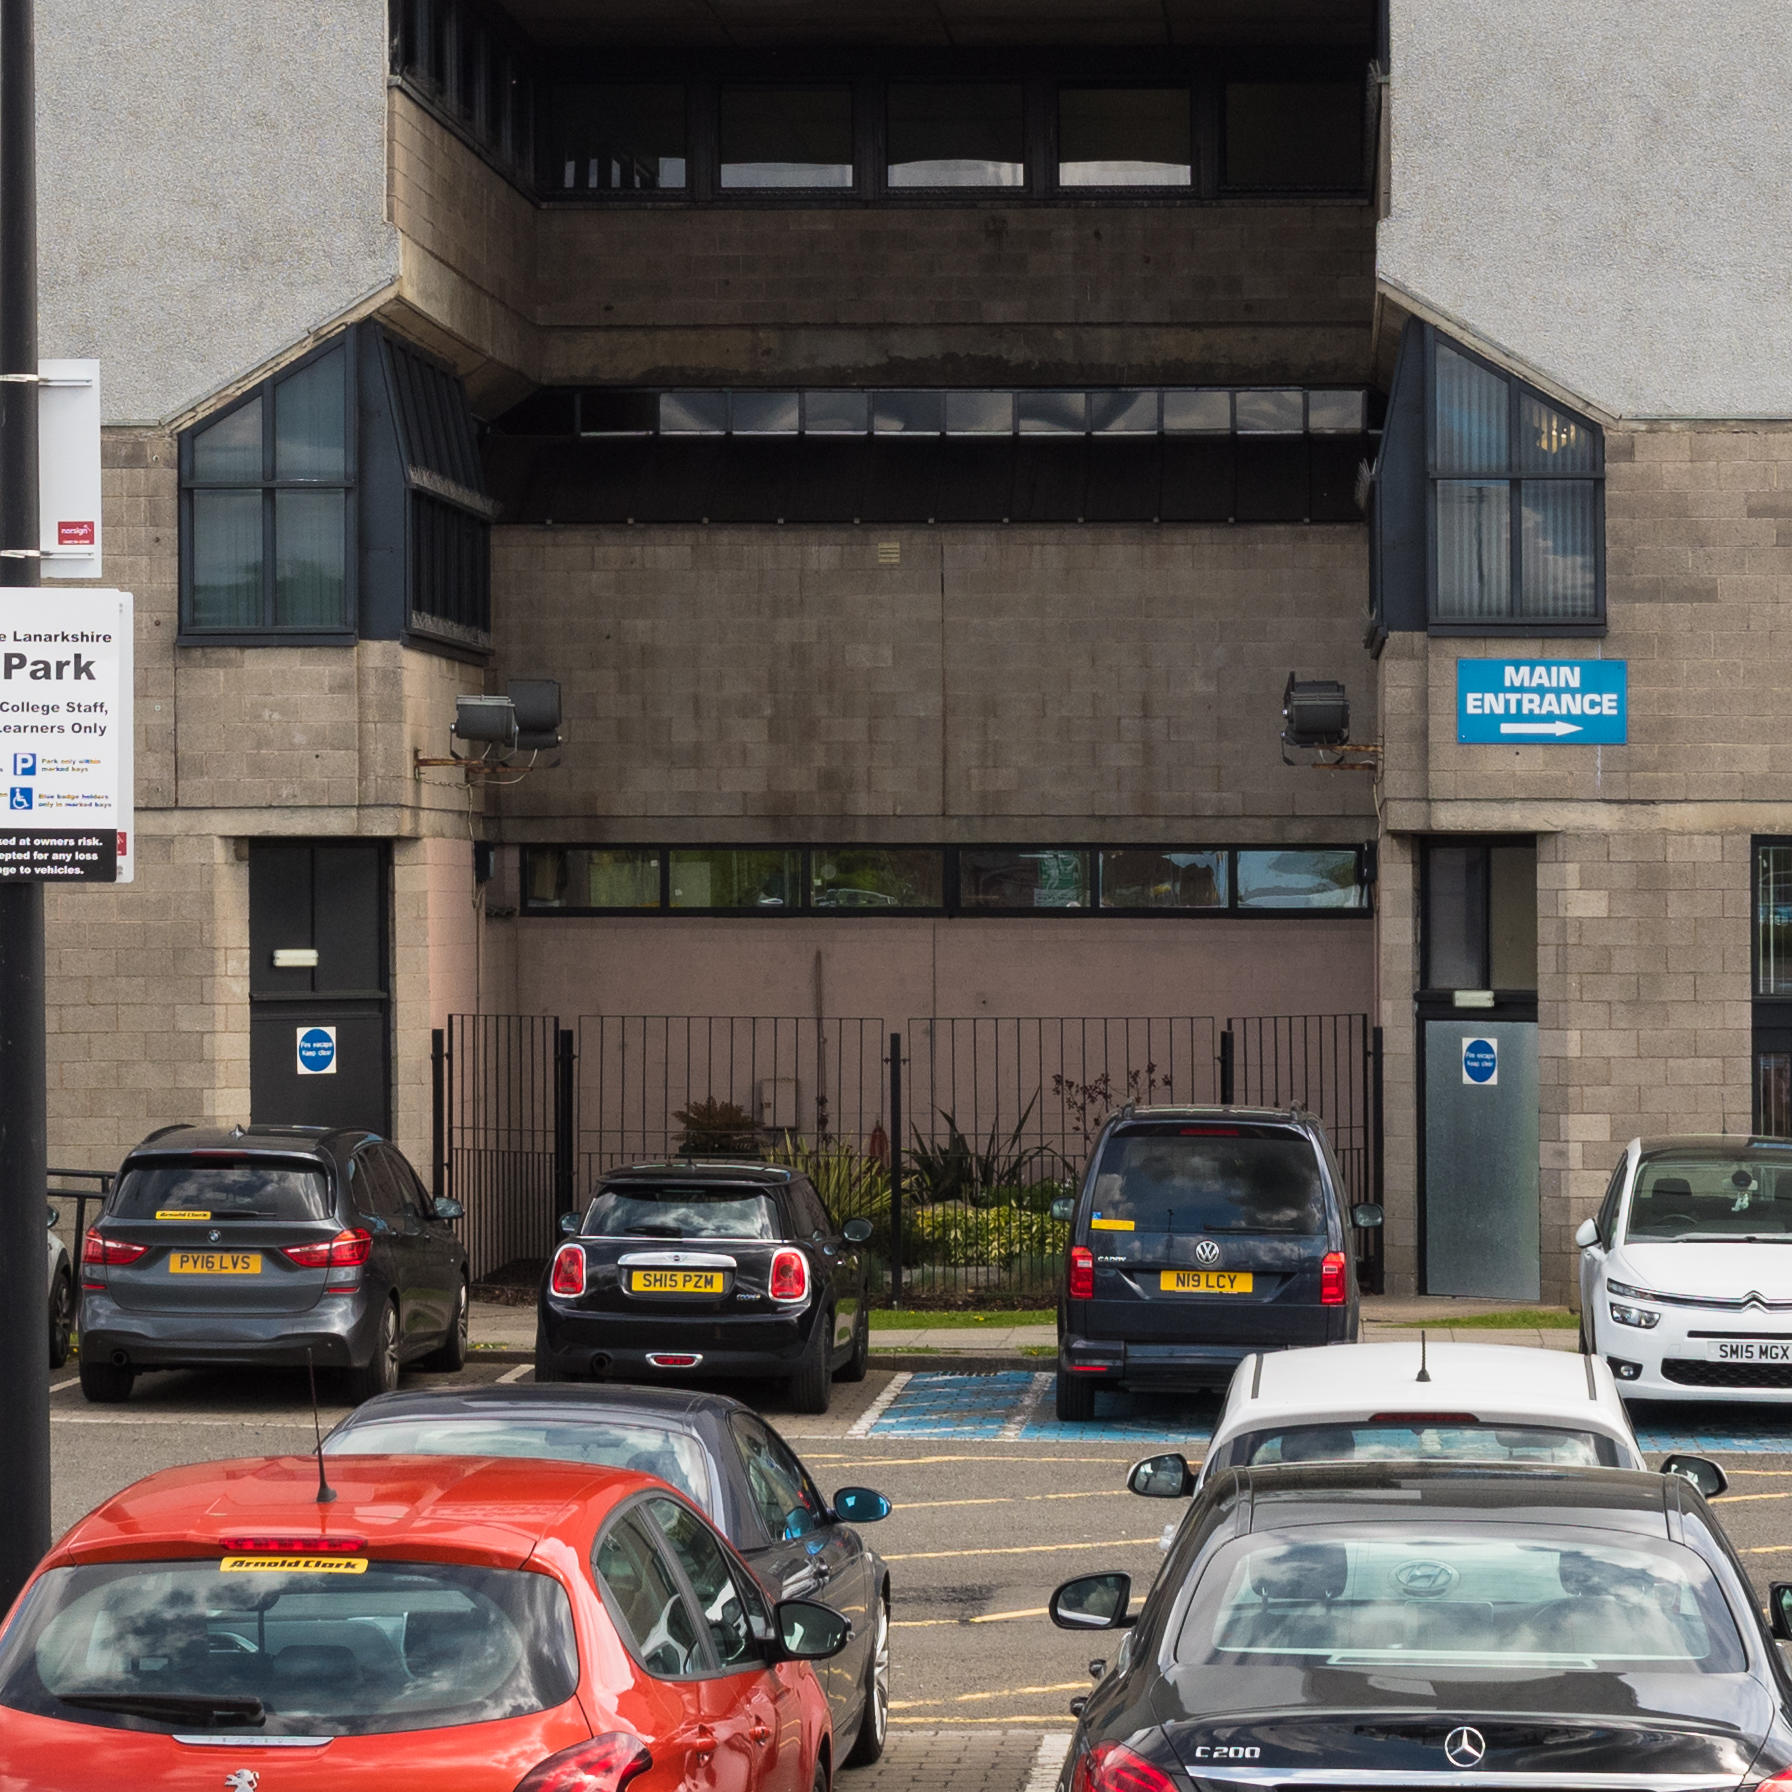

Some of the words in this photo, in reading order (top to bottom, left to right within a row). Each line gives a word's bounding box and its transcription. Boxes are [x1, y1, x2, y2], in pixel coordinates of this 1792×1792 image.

[13, 631, 112, 643] Lanarkshire
[3, 652, 96, 680] Park
[1504, 666, 1581, 689] MAIN
[0, 702, 60, 715] College
[66, 702, 108, 715] Staff,
[1466, 692, 1618, 715] ENTRANCE
[71, 723, 107, 736] Only
[19, 836, 31, 846] at
[34, 838, 75, 846] owners
[78, 836, 103, 846] risk.
[33, 850, 49, 860] for
[51, 853, 72, 862] any
[75, 851, 98, 861] loss
[20, 866, 31, 874] to
[34, 865, 84, 874] vehicles.
[180, 1255, 214, 1269] PY16
[220, 1255, 250, 1270] LVS
[643, 1273, 678, 1288] SH15
[683, 1274, 714, 1289] PZM
[1176, 1273, 1200, 1287] N19
[1206, 1274, 1237, 1289] LCY
[1719, 1344, 1754, 1359] SM15
[1759, 1345, 1790, 1360] MGX
[230, 1559, 300, 1568] Arnold
[303, 1559, 358, 1569] Clark
[1195, 1746, 1211, 1758] C
[1213, 1746, 1261, 1759] 200
